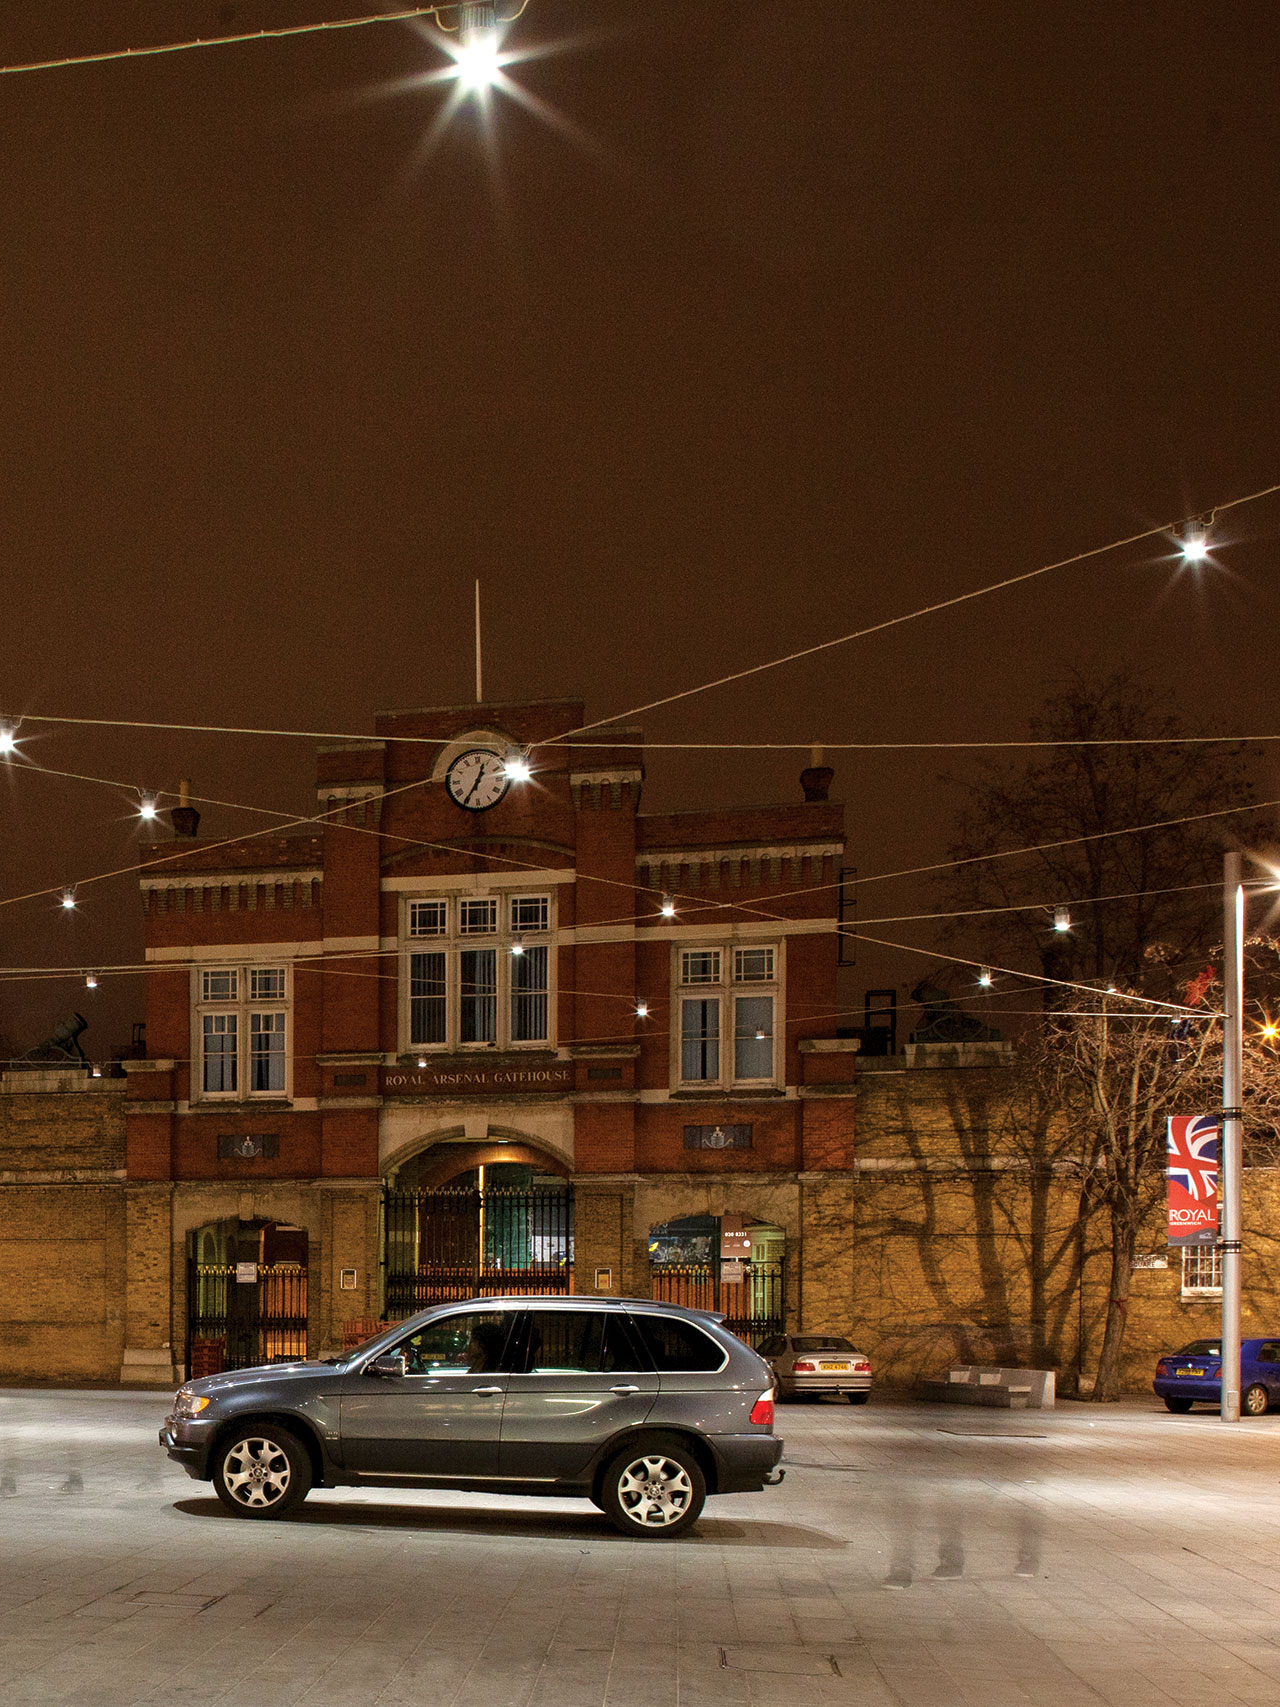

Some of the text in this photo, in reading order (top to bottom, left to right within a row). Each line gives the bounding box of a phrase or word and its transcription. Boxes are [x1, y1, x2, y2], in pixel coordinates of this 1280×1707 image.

[385, 1070, 570, 1087] ROYAL ARSENAL GATEHOUSE
[1169, 1209, 1216, 1221] ROYAL
